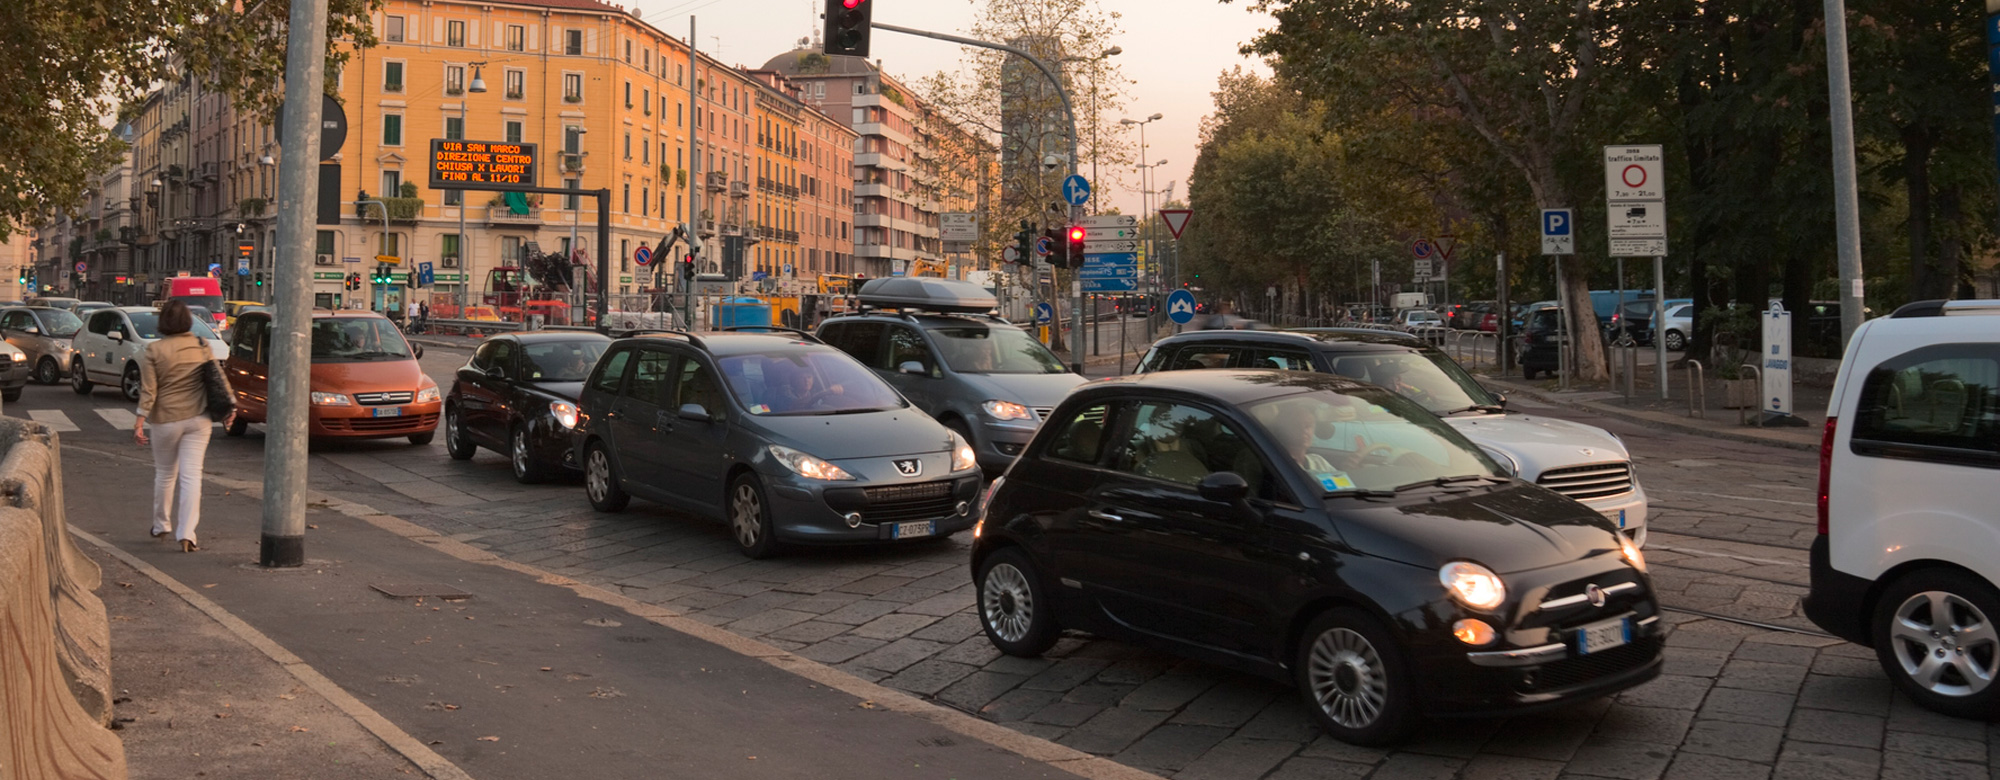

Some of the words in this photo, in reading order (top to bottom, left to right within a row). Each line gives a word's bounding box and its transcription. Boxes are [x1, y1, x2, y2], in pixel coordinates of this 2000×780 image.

[443, 142, 462, 151] VIA
[467, 143, 486, 152] SAN
[490, 144, 520, 154] MARCO
[436, 152, 491, 163] DIREZIONE
[495, 154, 532, 164] CENTRO
[1633, 154, 1660, 162] limitato
[436, 162, 473, 171] CHIUSA
[478, 163, 485, 171] X
[489, 163, 525, 173] LAVORI
[442, 172, 467, 181] FINO
[471, 172, 485, 182] AL
[490, 173, 520, 183] 11/10
[1549, 214, 1564, 232] P
[421, 263, 430, 274] P
